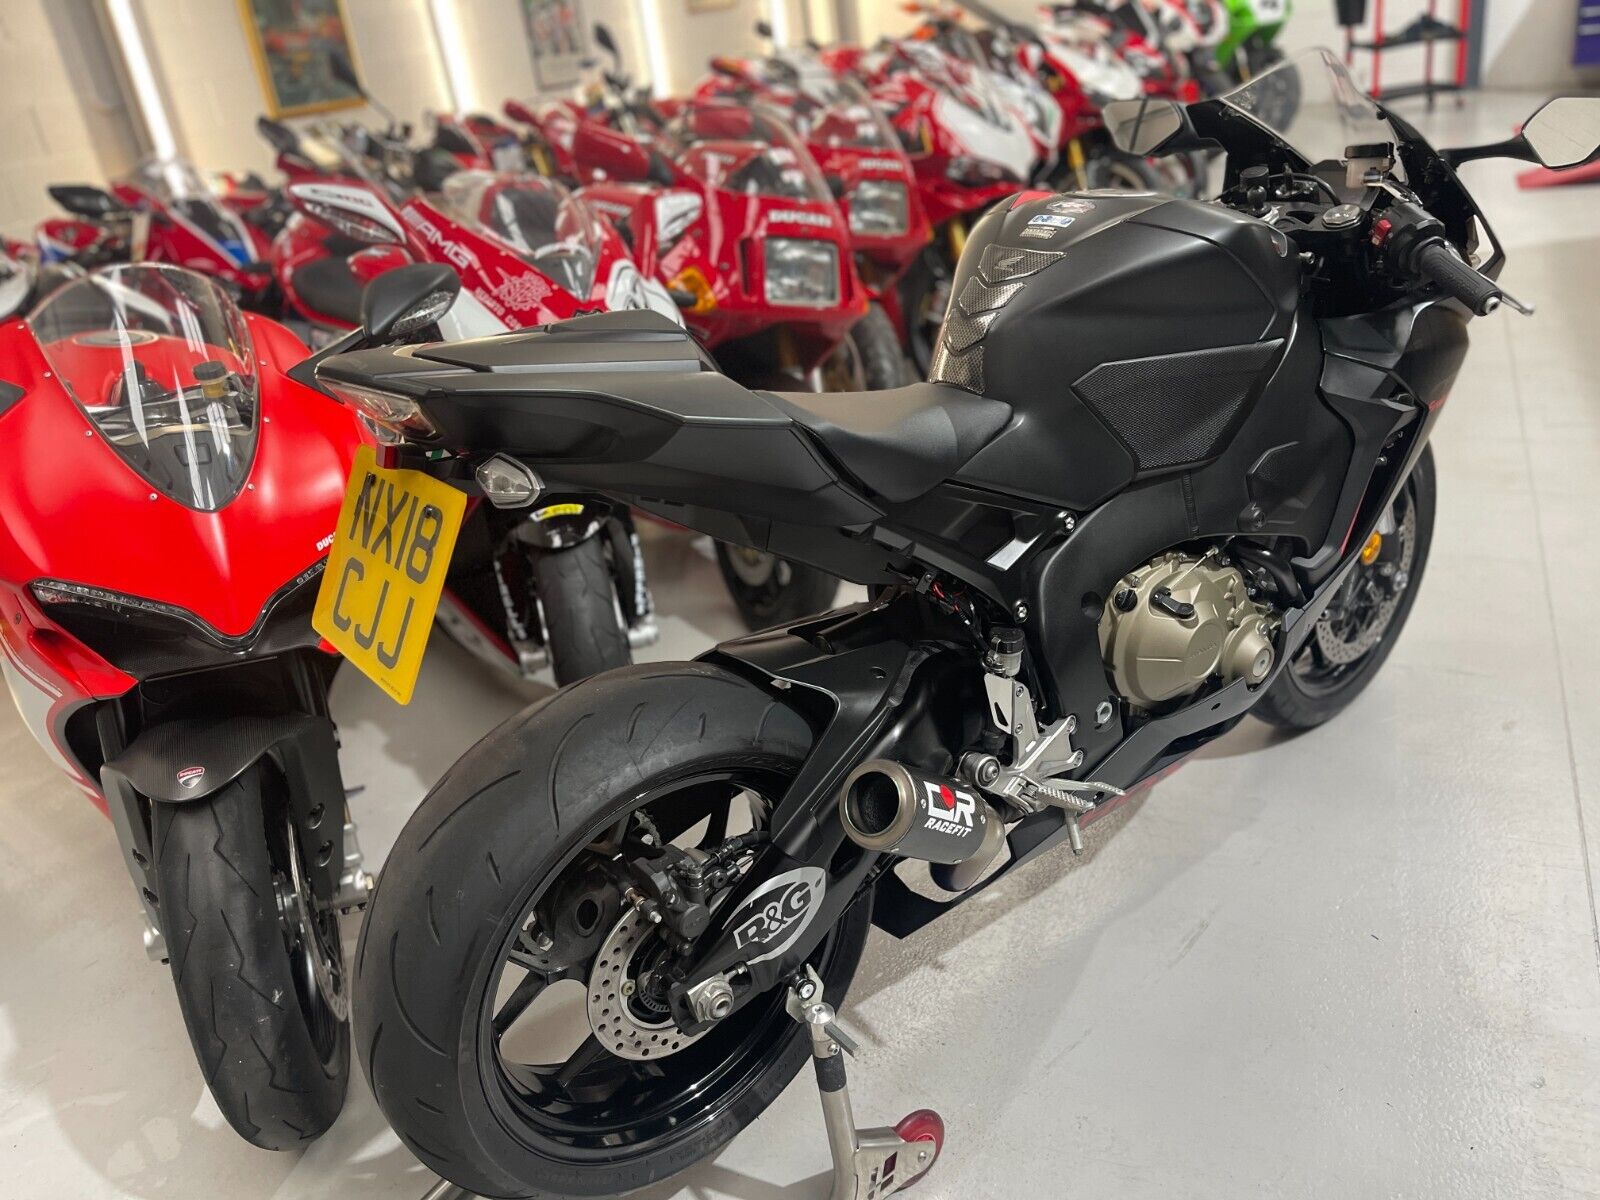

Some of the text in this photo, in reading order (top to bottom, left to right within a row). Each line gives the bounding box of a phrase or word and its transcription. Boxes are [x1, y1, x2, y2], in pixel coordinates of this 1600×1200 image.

[417, 221, 472, 269] AMG
[768, 209, 833, 228] DUCATI
[349, 471, 444, 585] NX18
[332, 556, 415, 670] CJJ
[923, 816, 973, 838] RACEFIT
[733, 880, 813, 949] R&G
